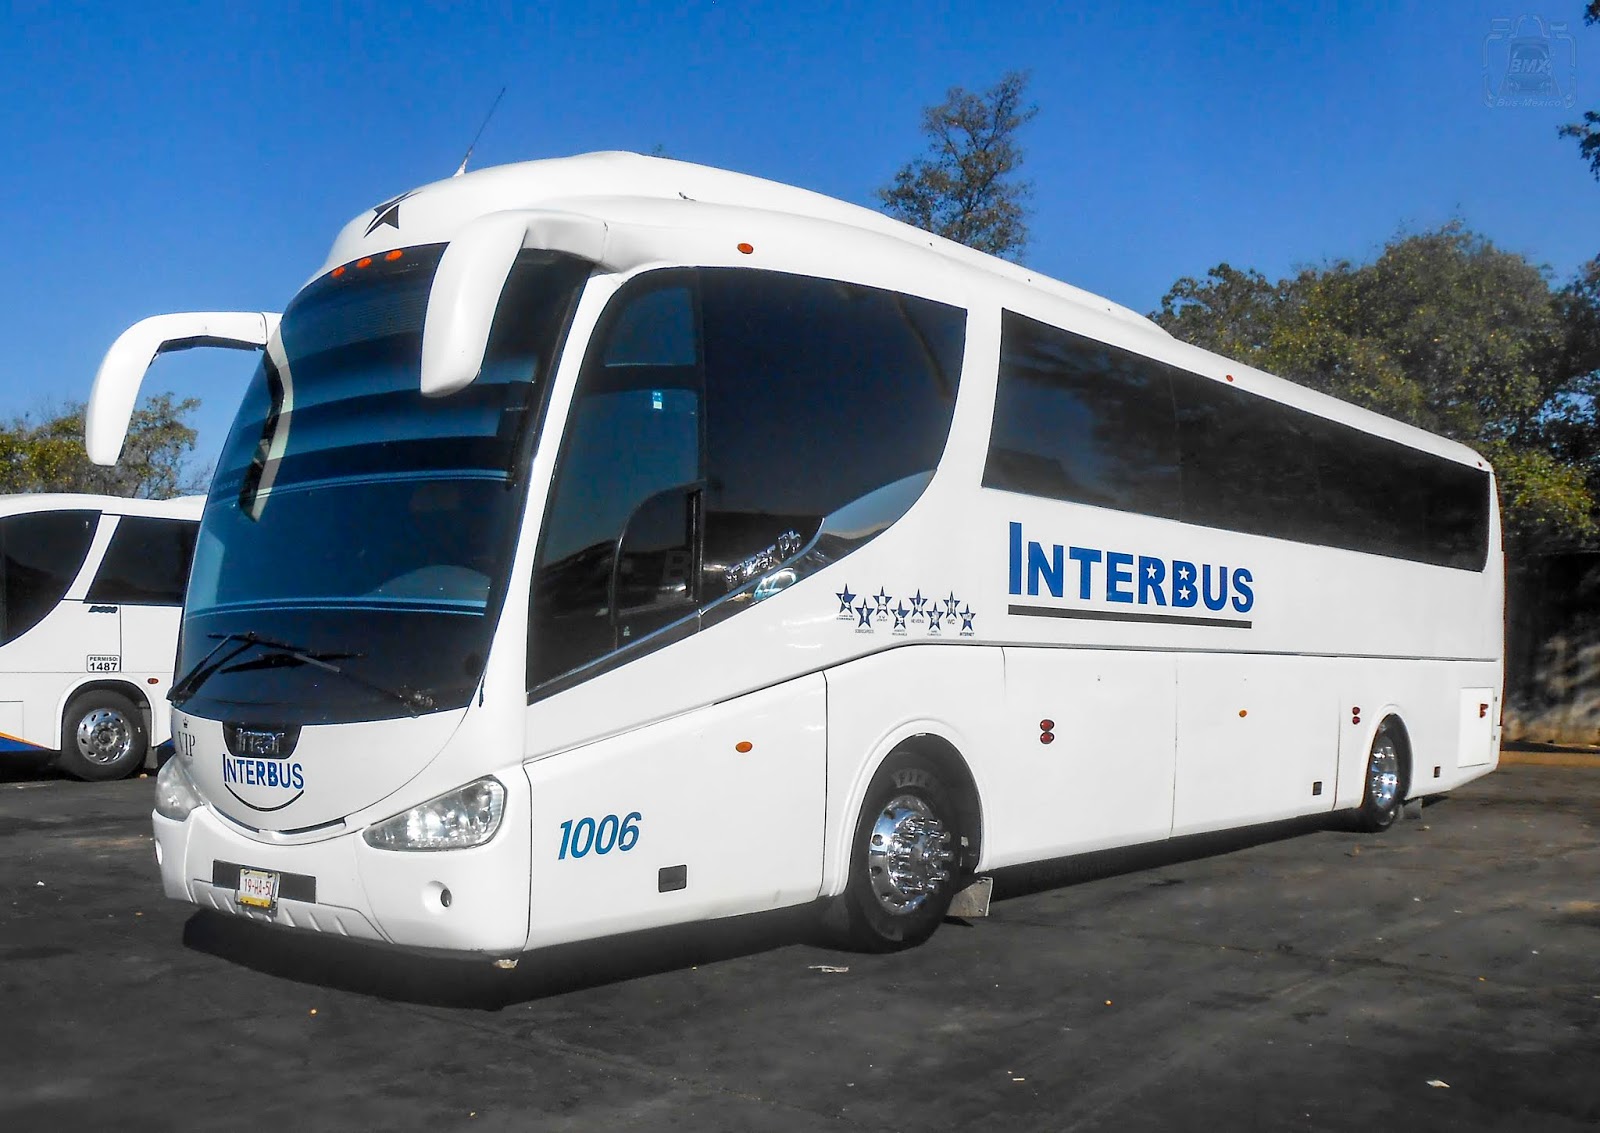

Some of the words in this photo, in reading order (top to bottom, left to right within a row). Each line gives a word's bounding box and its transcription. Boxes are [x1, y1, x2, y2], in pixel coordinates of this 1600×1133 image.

[1008, 521, 1254, 613] INTERBUS
[89, 662, 118, 671] 1487
[177, 731, 196, 757] VIP
[222, 753, 305, 790] INTERBUS
[558, 811, 642, 860] 1006
